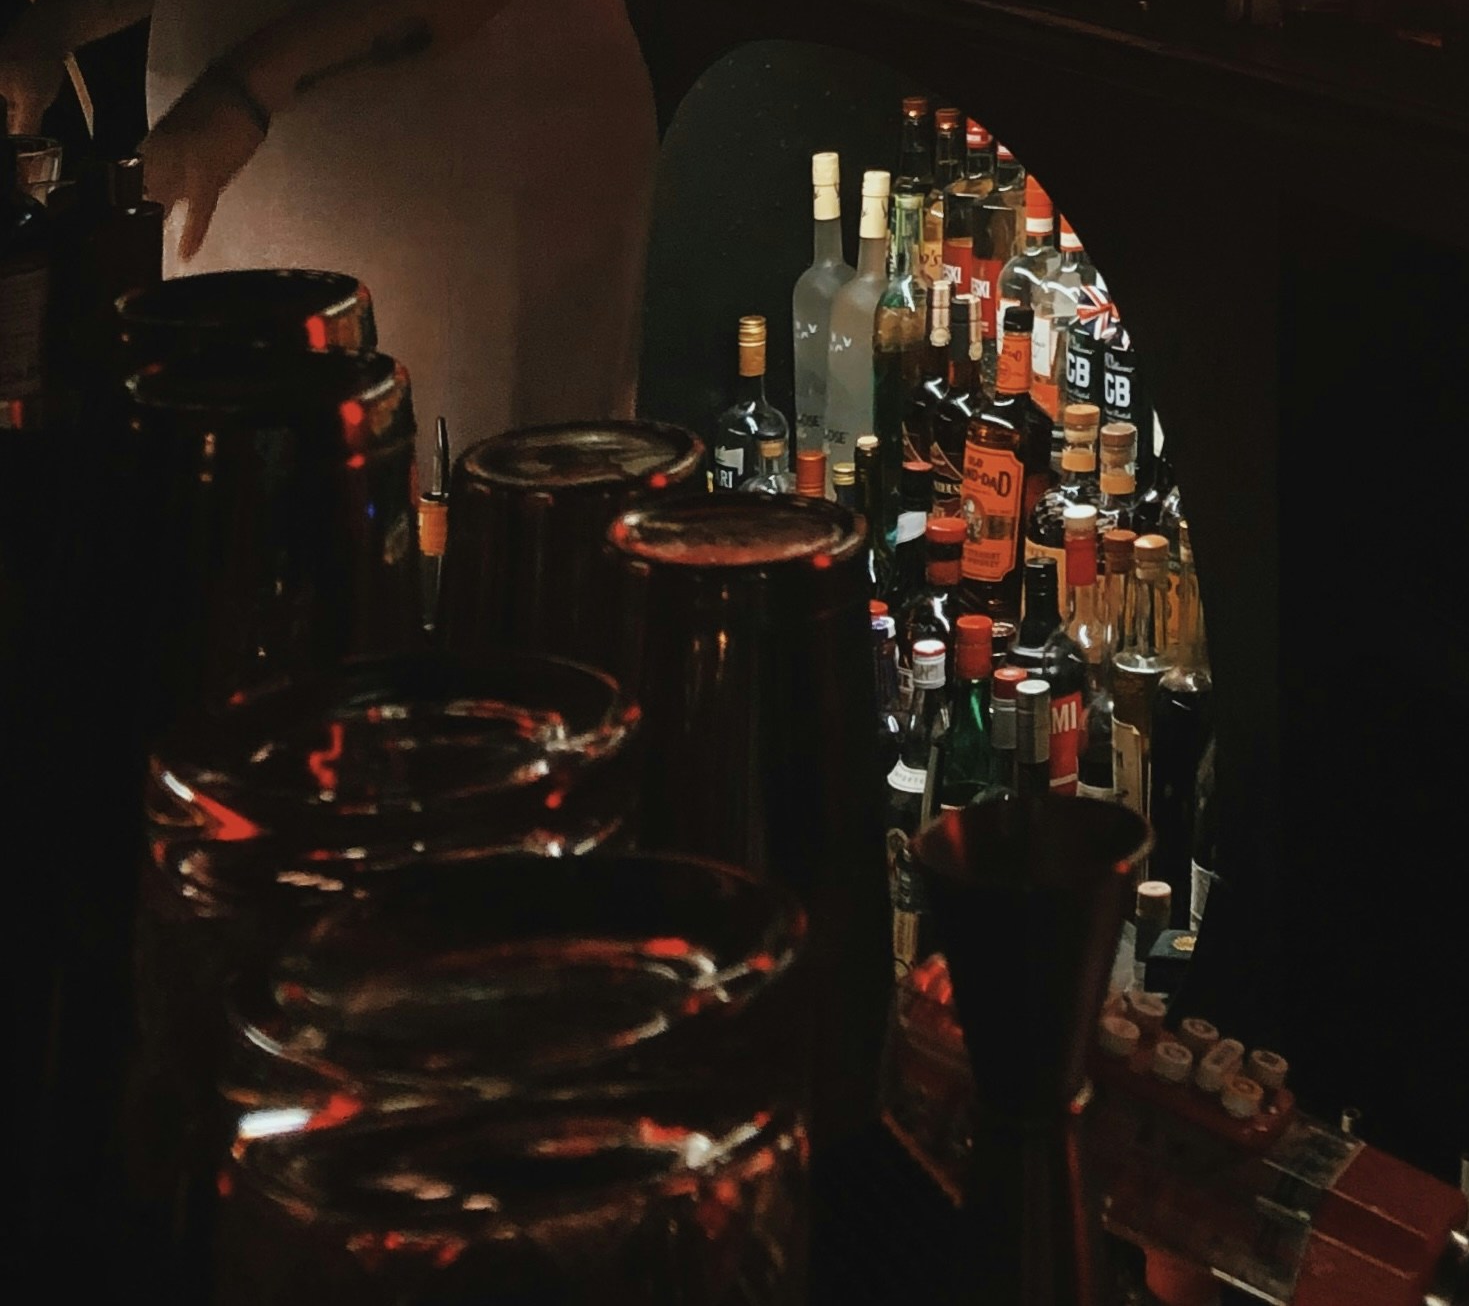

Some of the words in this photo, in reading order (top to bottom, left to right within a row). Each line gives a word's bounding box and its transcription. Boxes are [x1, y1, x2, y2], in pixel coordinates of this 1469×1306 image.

[1066, 351, 1091, 388] GB
[1104, 371, 1131, 408] GB
[1051, 701, 1076, 735] MI
